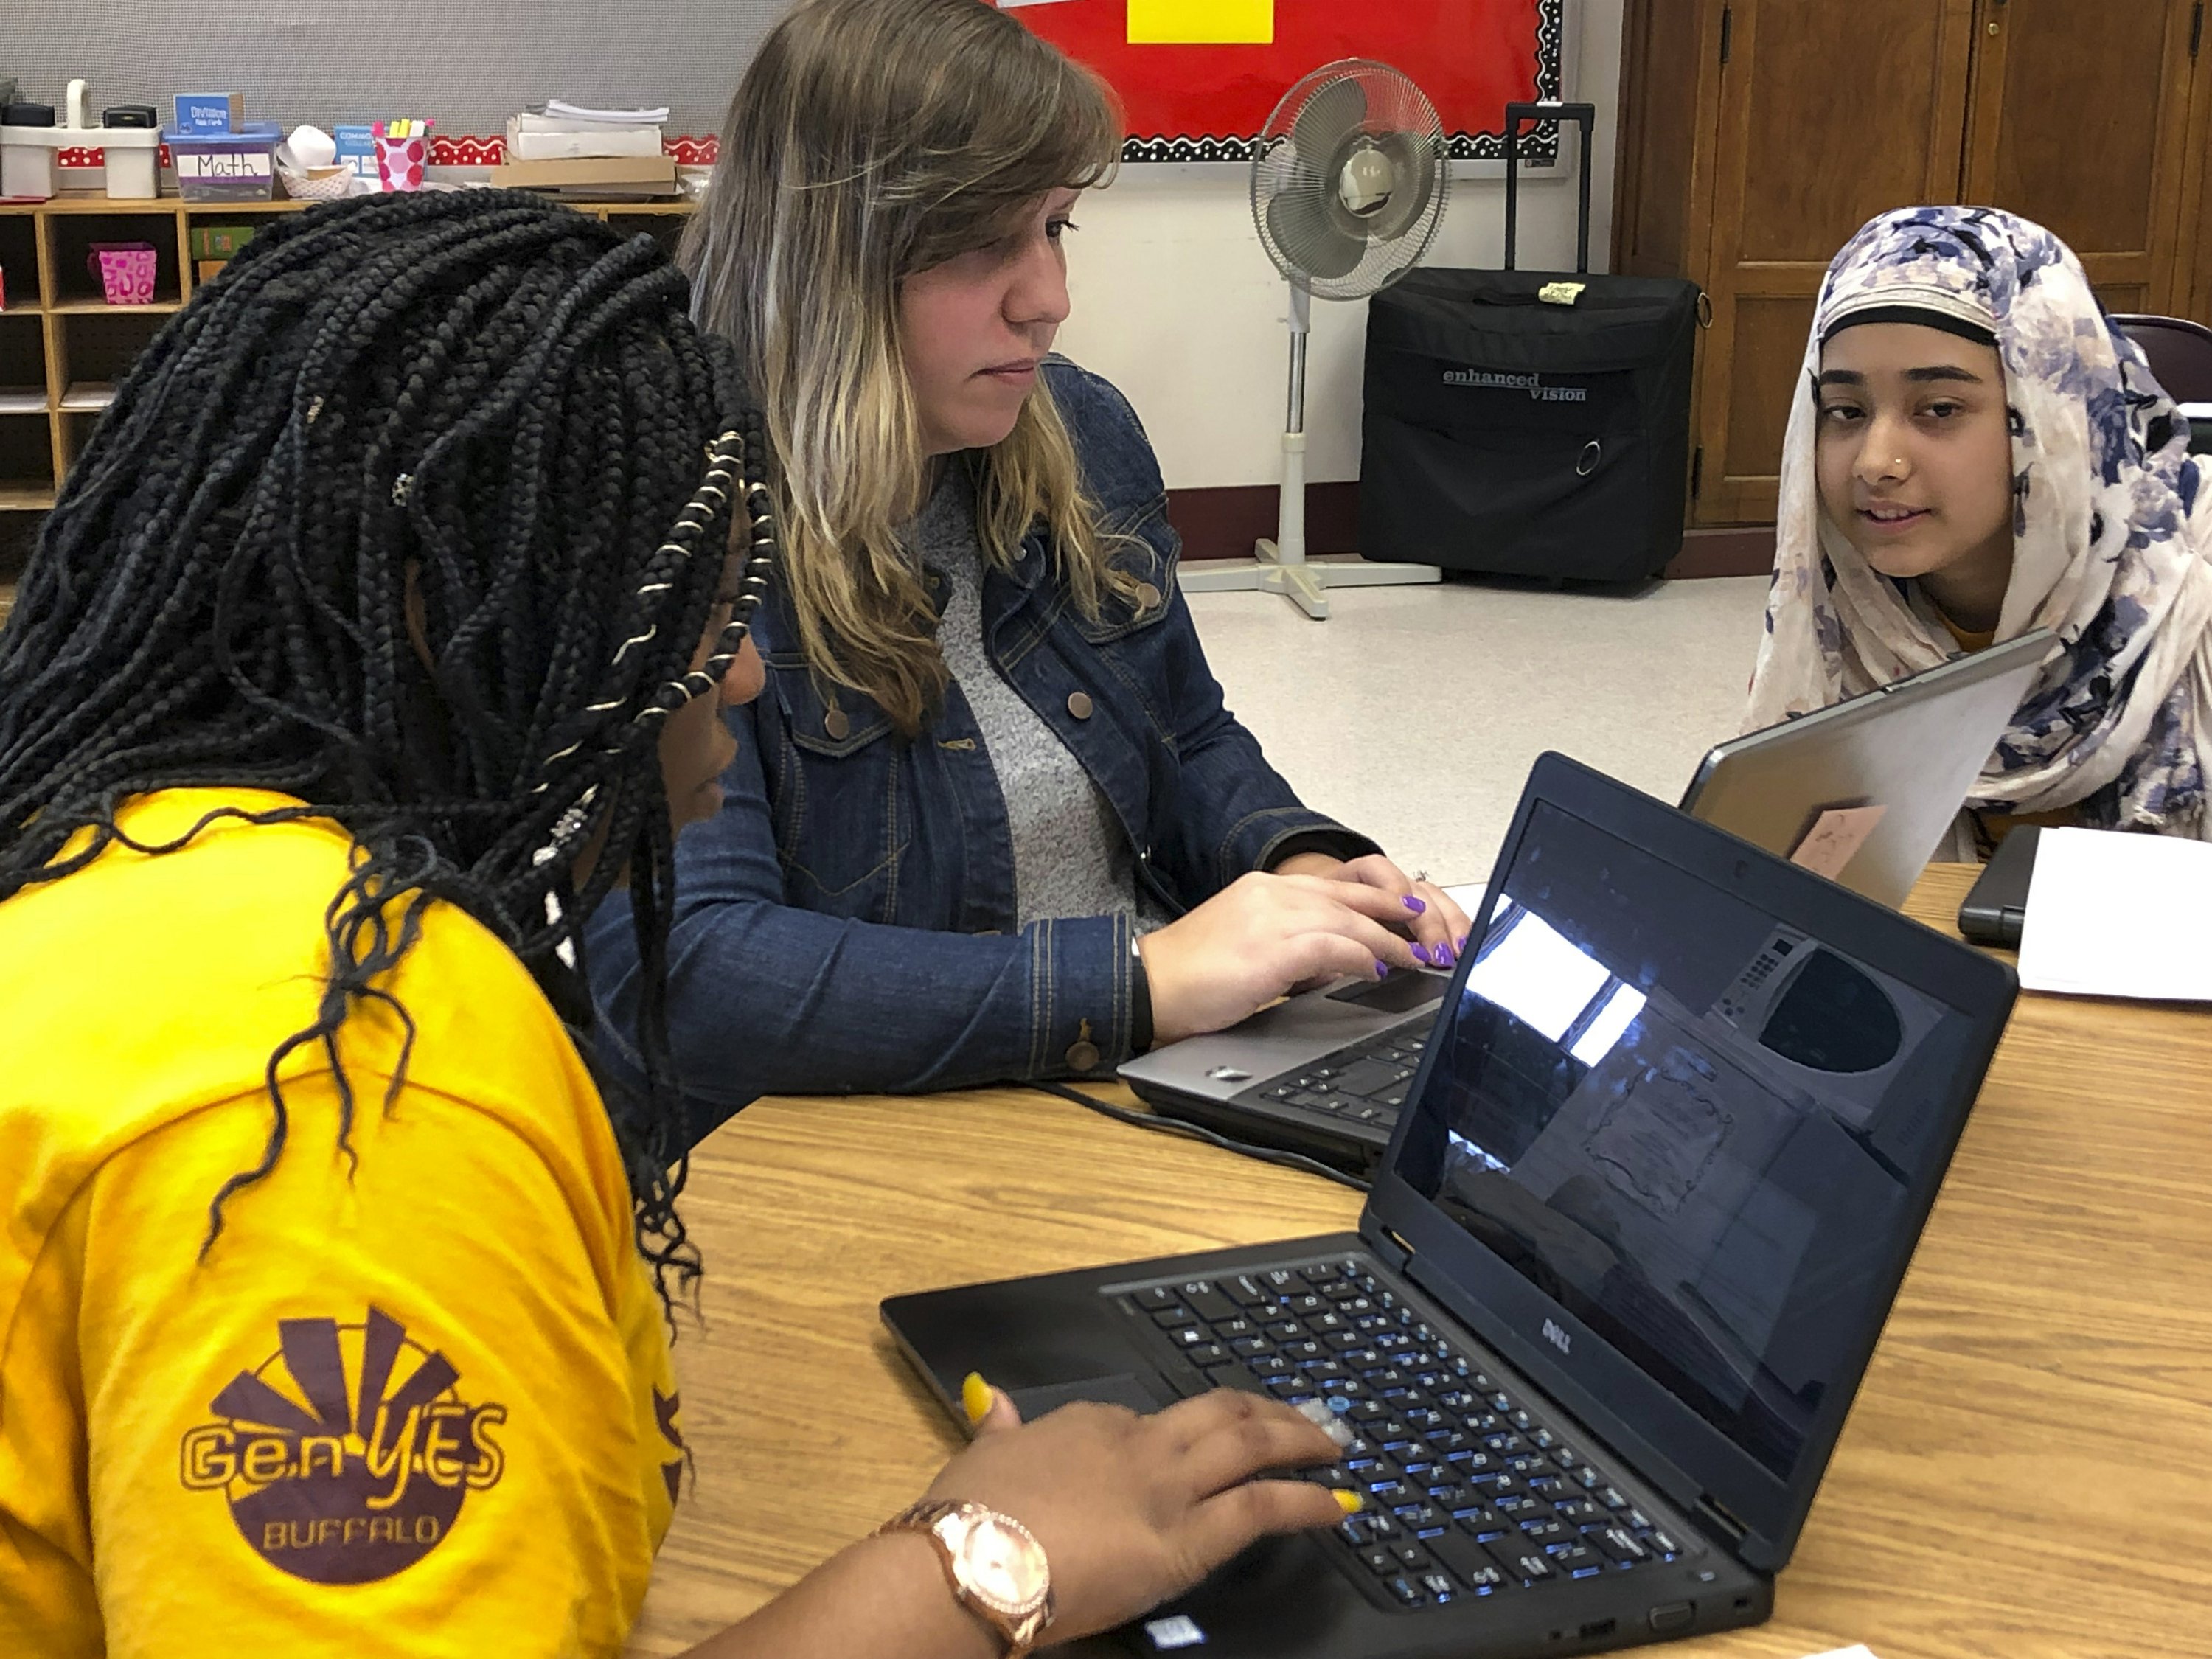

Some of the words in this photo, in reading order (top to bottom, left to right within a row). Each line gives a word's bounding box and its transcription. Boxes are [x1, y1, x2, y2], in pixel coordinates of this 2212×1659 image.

[197, 153, 258, 176] Math
[1442, 369, 1540, 386] enhanced
[1530, 387, 1586, 401] vision
[262, 1515, 441, 1550] BUFFALO
